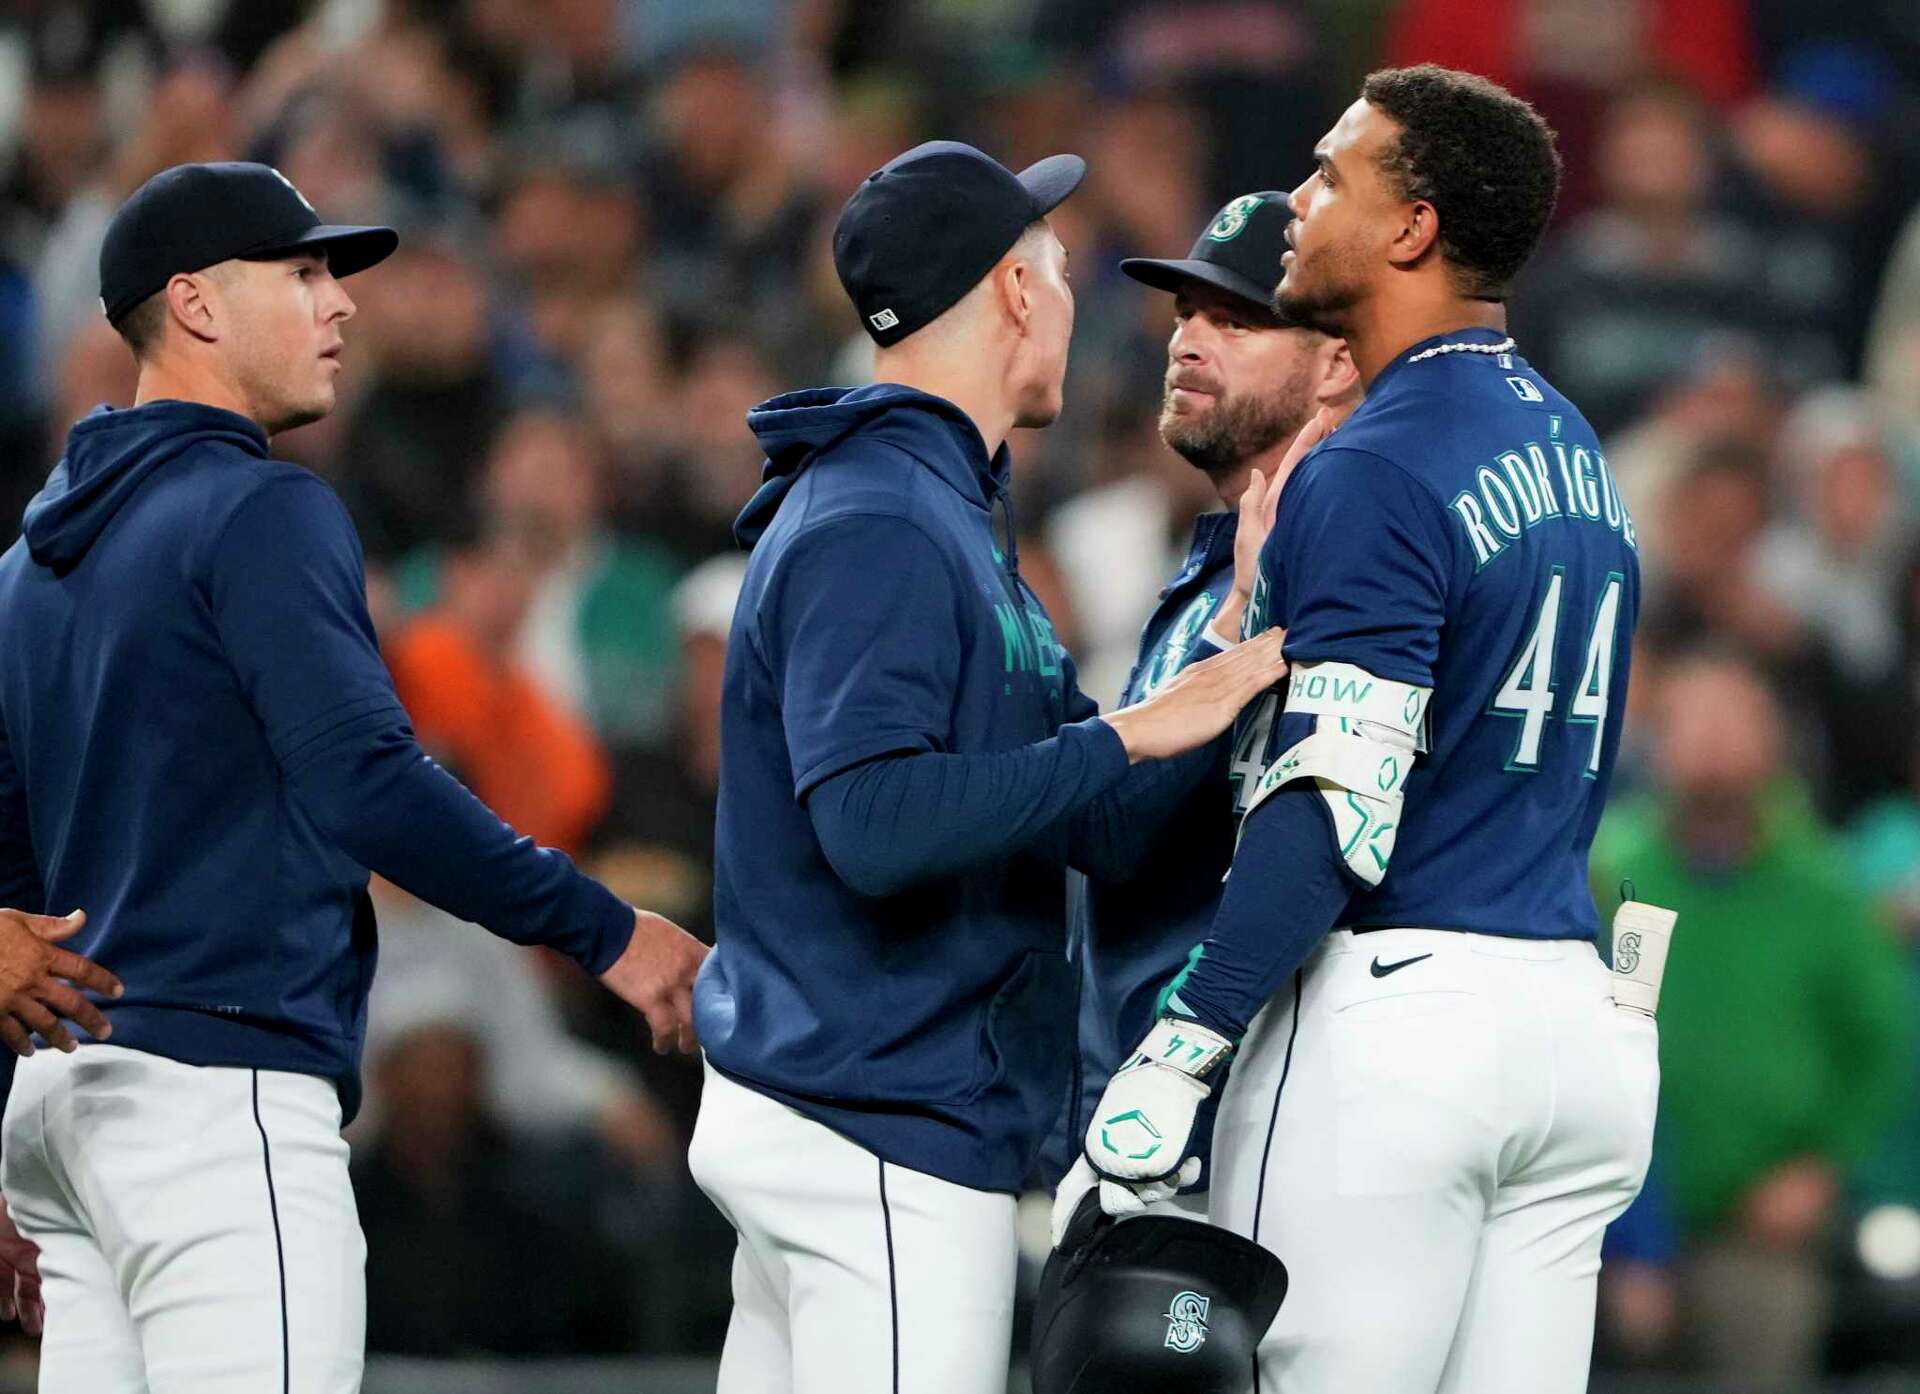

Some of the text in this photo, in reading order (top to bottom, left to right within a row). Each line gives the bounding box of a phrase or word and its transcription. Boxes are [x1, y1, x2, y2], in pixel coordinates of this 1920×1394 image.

[1208, 195, 1264, 242] S
[1486, 565, 1625, 780] 44
[1616, 932, 1641, 974] S
[1164, 1291, 1210, 1353] S
